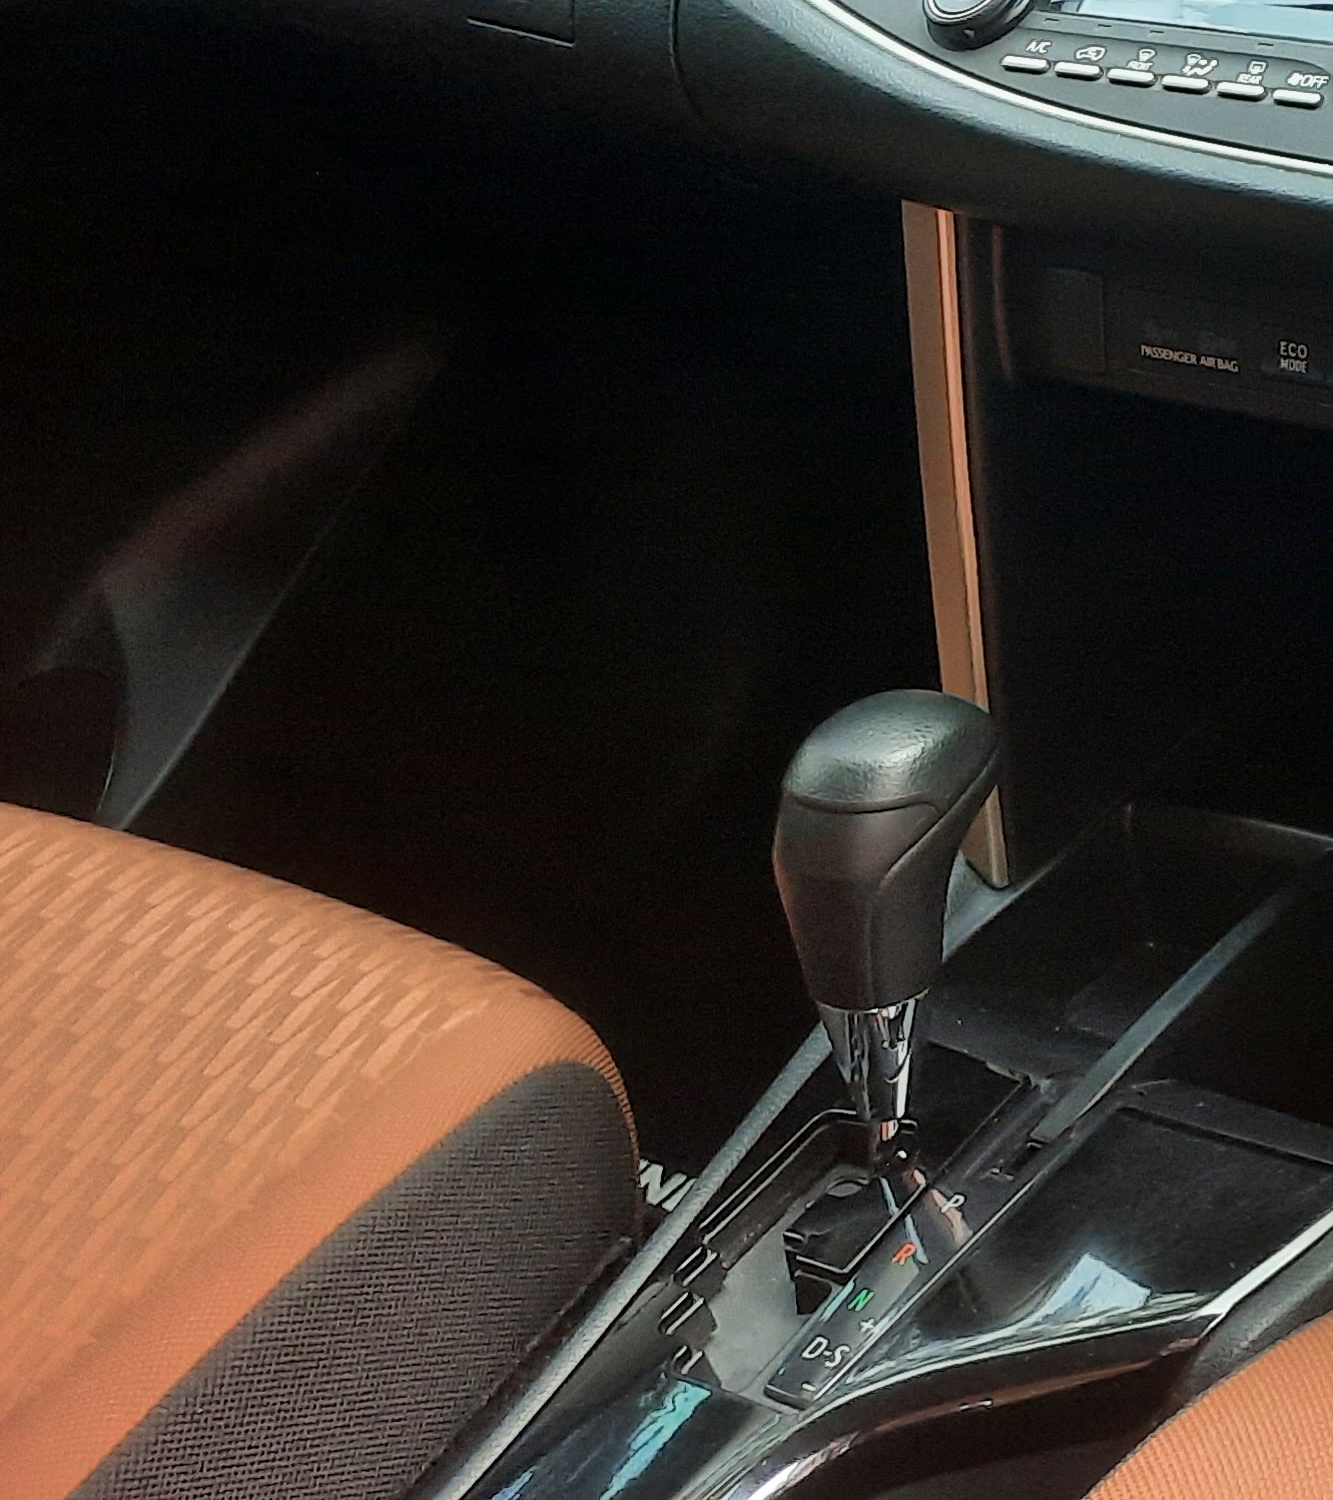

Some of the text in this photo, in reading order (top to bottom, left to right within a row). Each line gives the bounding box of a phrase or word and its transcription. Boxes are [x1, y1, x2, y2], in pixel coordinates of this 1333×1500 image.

[1026, 40, 1051, 53] A/C
[1300, 75, 1330, 88] OFF
[1140, 344, 1198, 365] PASSENGER
[1280, 341, 1307, 359] ECO
[1280, 358, 1307, 374] MODE
[941, 1194, 965, 1213] P
[891, 1242, 916, 1265] R
[848, 1289, 874, 1311] N
